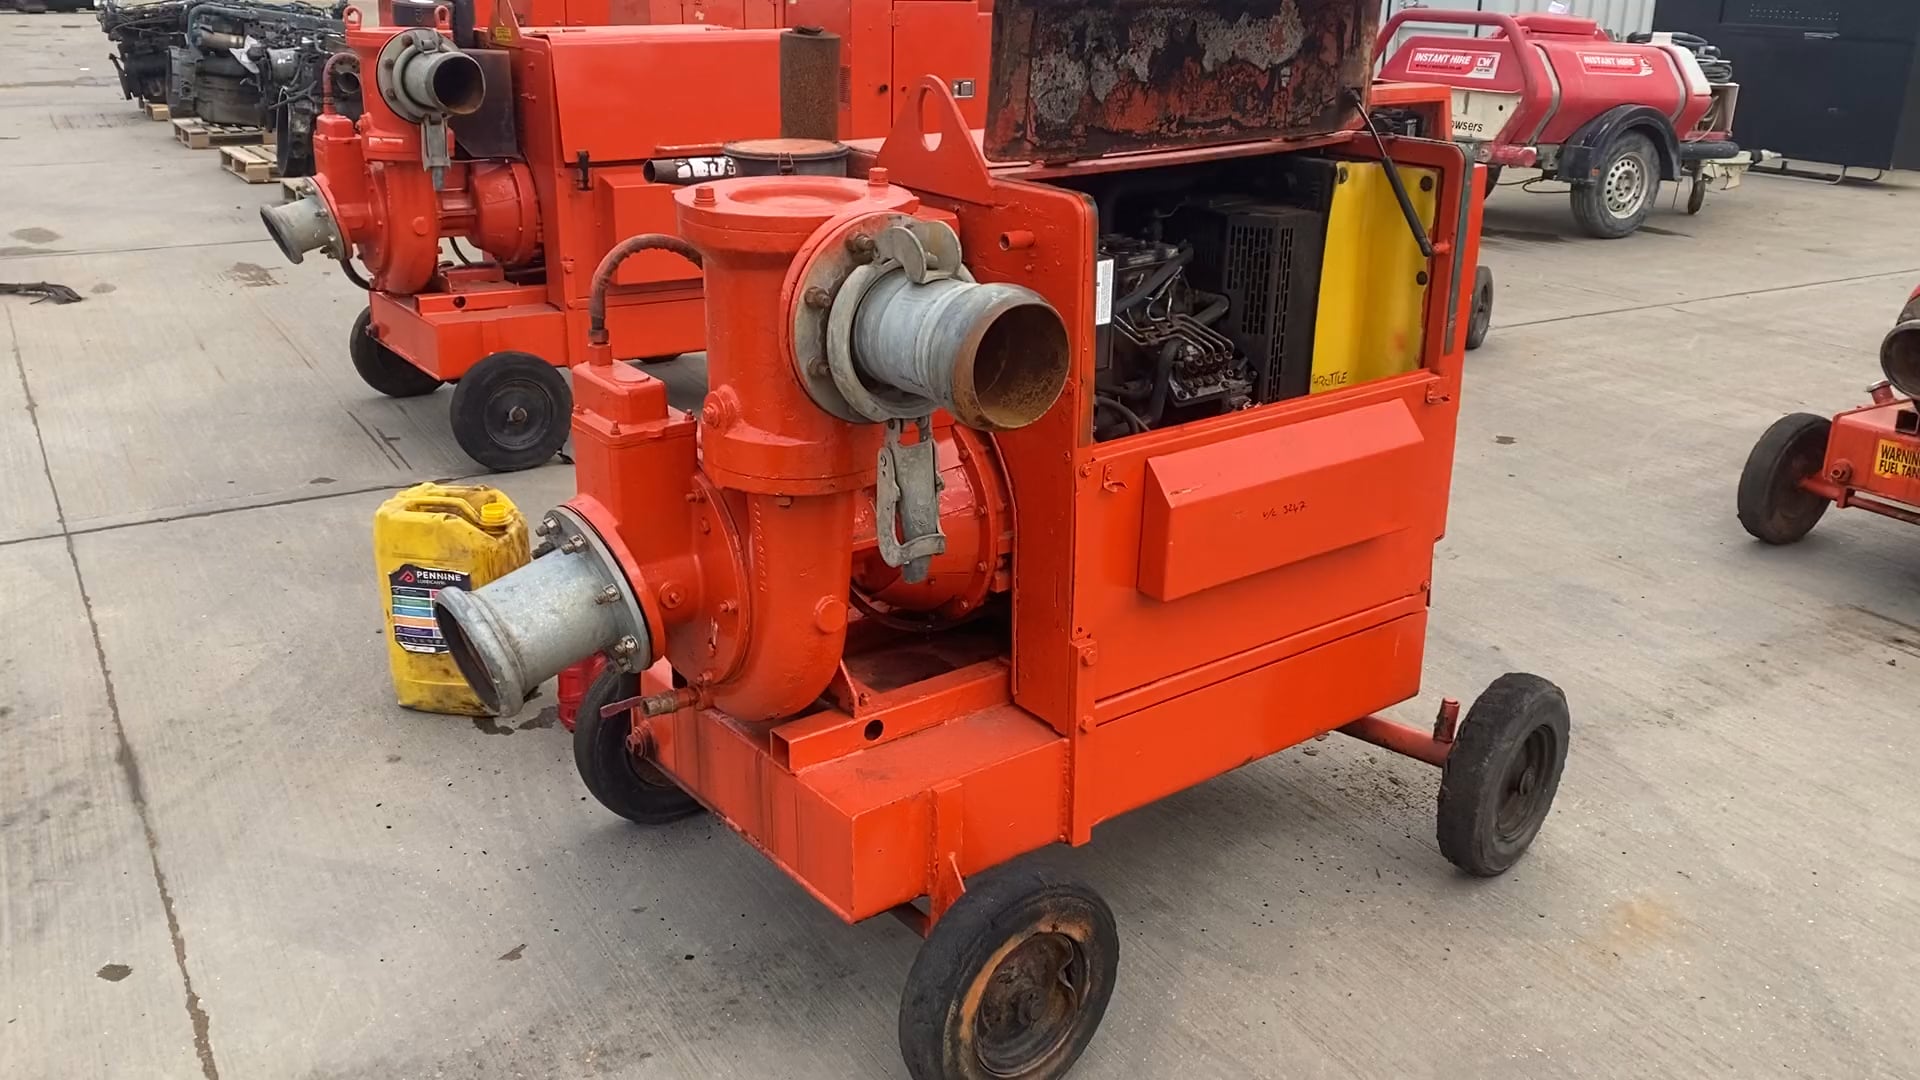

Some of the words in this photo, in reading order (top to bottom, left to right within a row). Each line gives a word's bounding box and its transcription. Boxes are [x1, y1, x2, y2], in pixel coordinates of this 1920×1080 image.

[1414, 53, 1450, 64] INSTANT
[1449, 55, 1472, 65] HIRE
[1583, 55, 1616, 65] INSTANT
[1616, 57, 1636, 66] HIRE
[1881, 444, 1920, 468] WARNIN
[1879, 460, 1898, 475] FUEL
[416, 571, 462, 582] PENNINE
